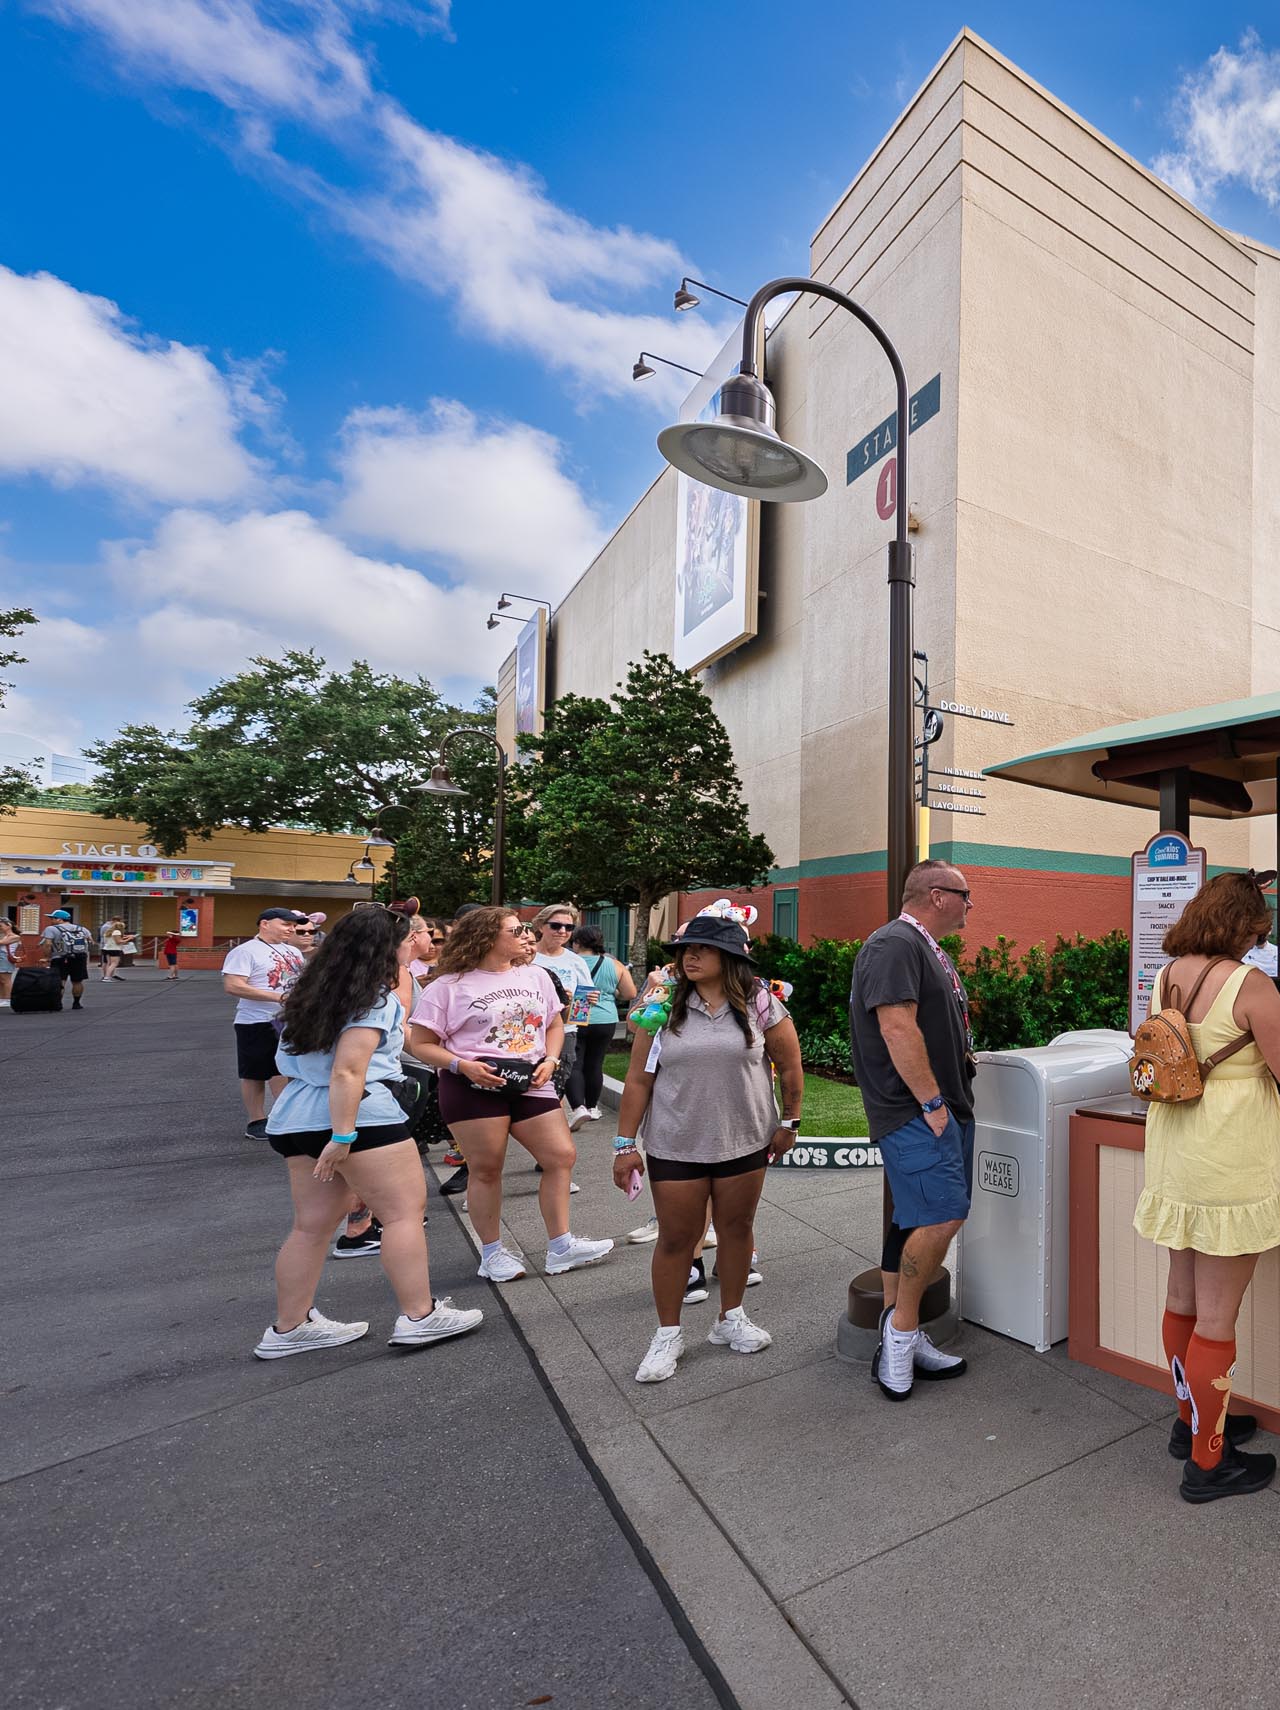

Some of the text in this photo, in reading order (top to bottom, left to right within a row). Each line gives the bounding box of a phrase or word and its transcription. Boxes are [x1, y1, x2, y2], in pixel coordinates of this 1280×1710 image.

[864, 401, 918, 465] STAE
[884, 470, 894, 509] 1
[940, 700, 1009, 723] DOPEY DRIVE
[939, 784, 967, 794] SPECIAL
[933, 800, 963, 811] LAYOUT
[62, 843, 132, 857] STAGE
[1155, 854, 1180, 862] SUMMER
[14, 866, 46, 876] Disney
[61, 862, 157, 872] MICKEY MOUSE
[62, 870, 156, 882] CLUBHOUSE
[162, 868, 203, 880] LIVE
[834, 1148, 884, 1166] COR
[985, 1159, 1012, 1176] WASTE
[984, 1173, 1013, 1191] PLEASE
